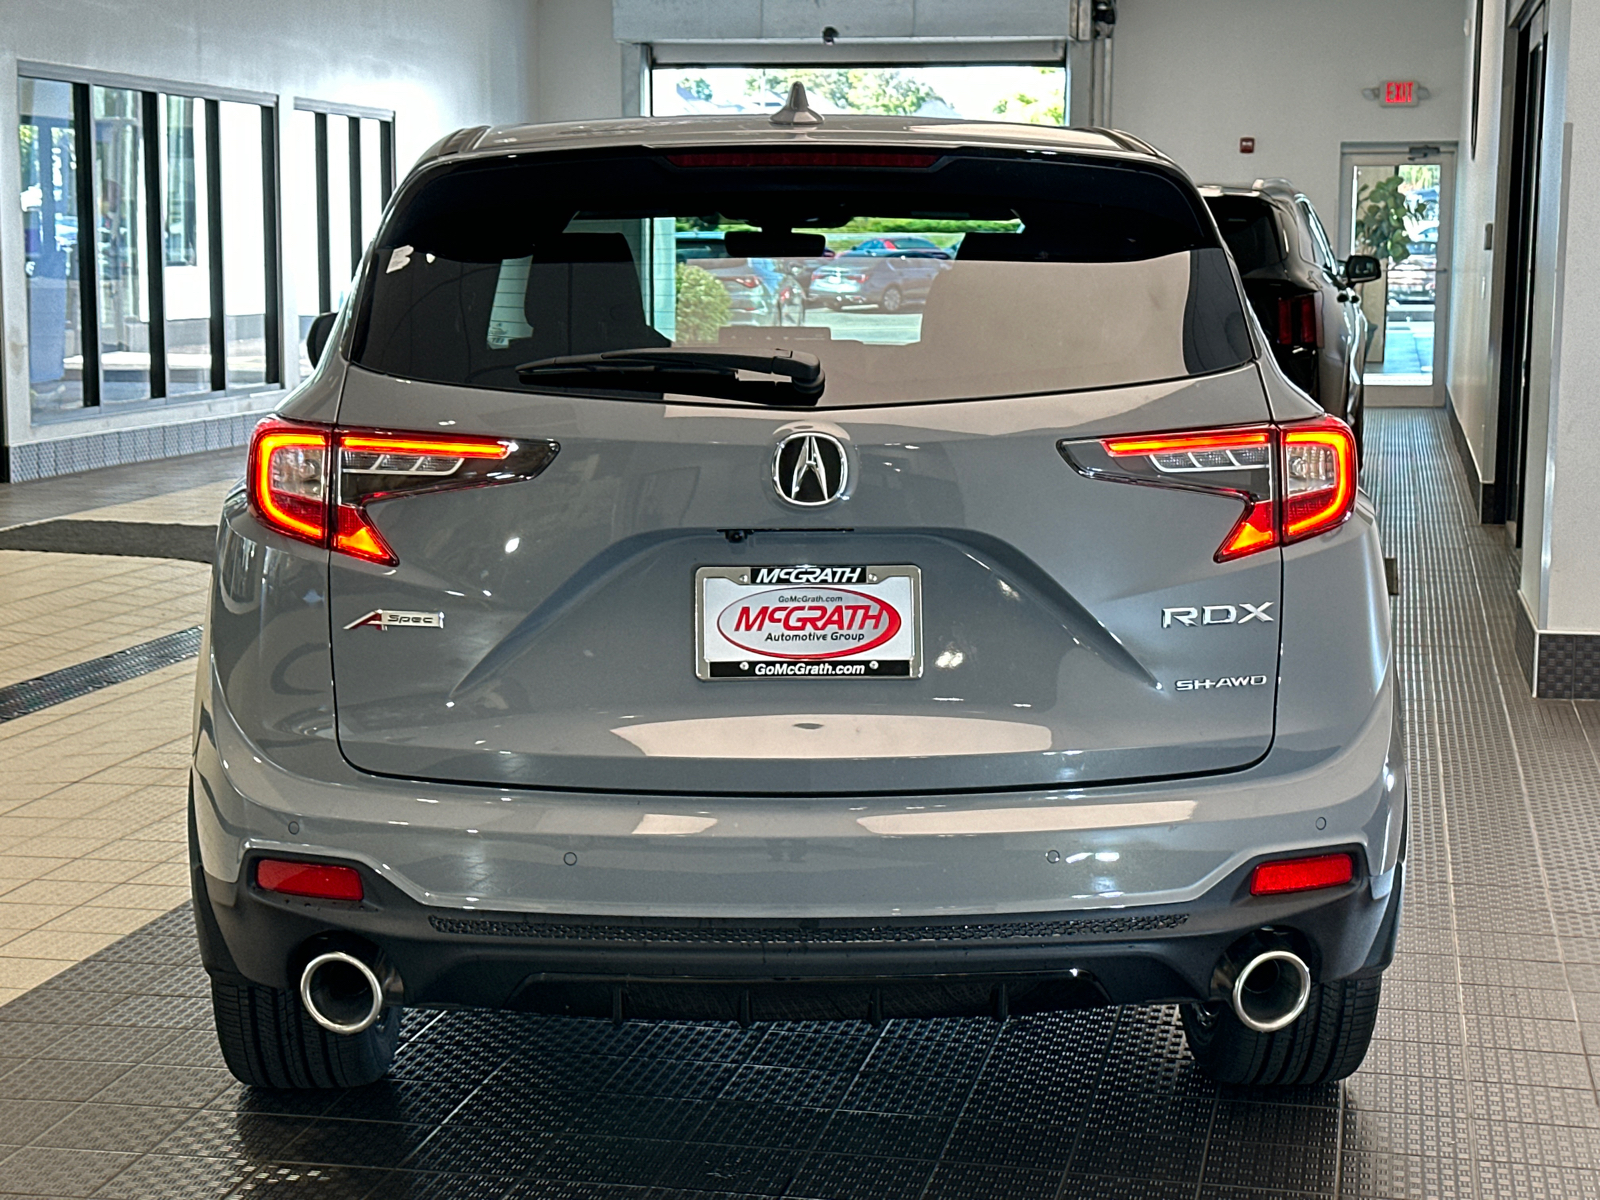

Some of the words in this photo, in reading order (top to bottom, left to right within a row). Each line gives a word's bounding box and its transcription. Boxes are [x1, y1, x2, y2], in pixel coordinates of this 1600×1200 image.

[1385, 81, 1414, 103] EXIT
[778, 594, 843, 604] GoMcGrath.com
[1161, 601, 1275, 628] RDX
[764, 631, 828, 642] Automotive
[830, 631, 865, 643] Group
[754, 661, 866, 676] GoMcGrath.com
